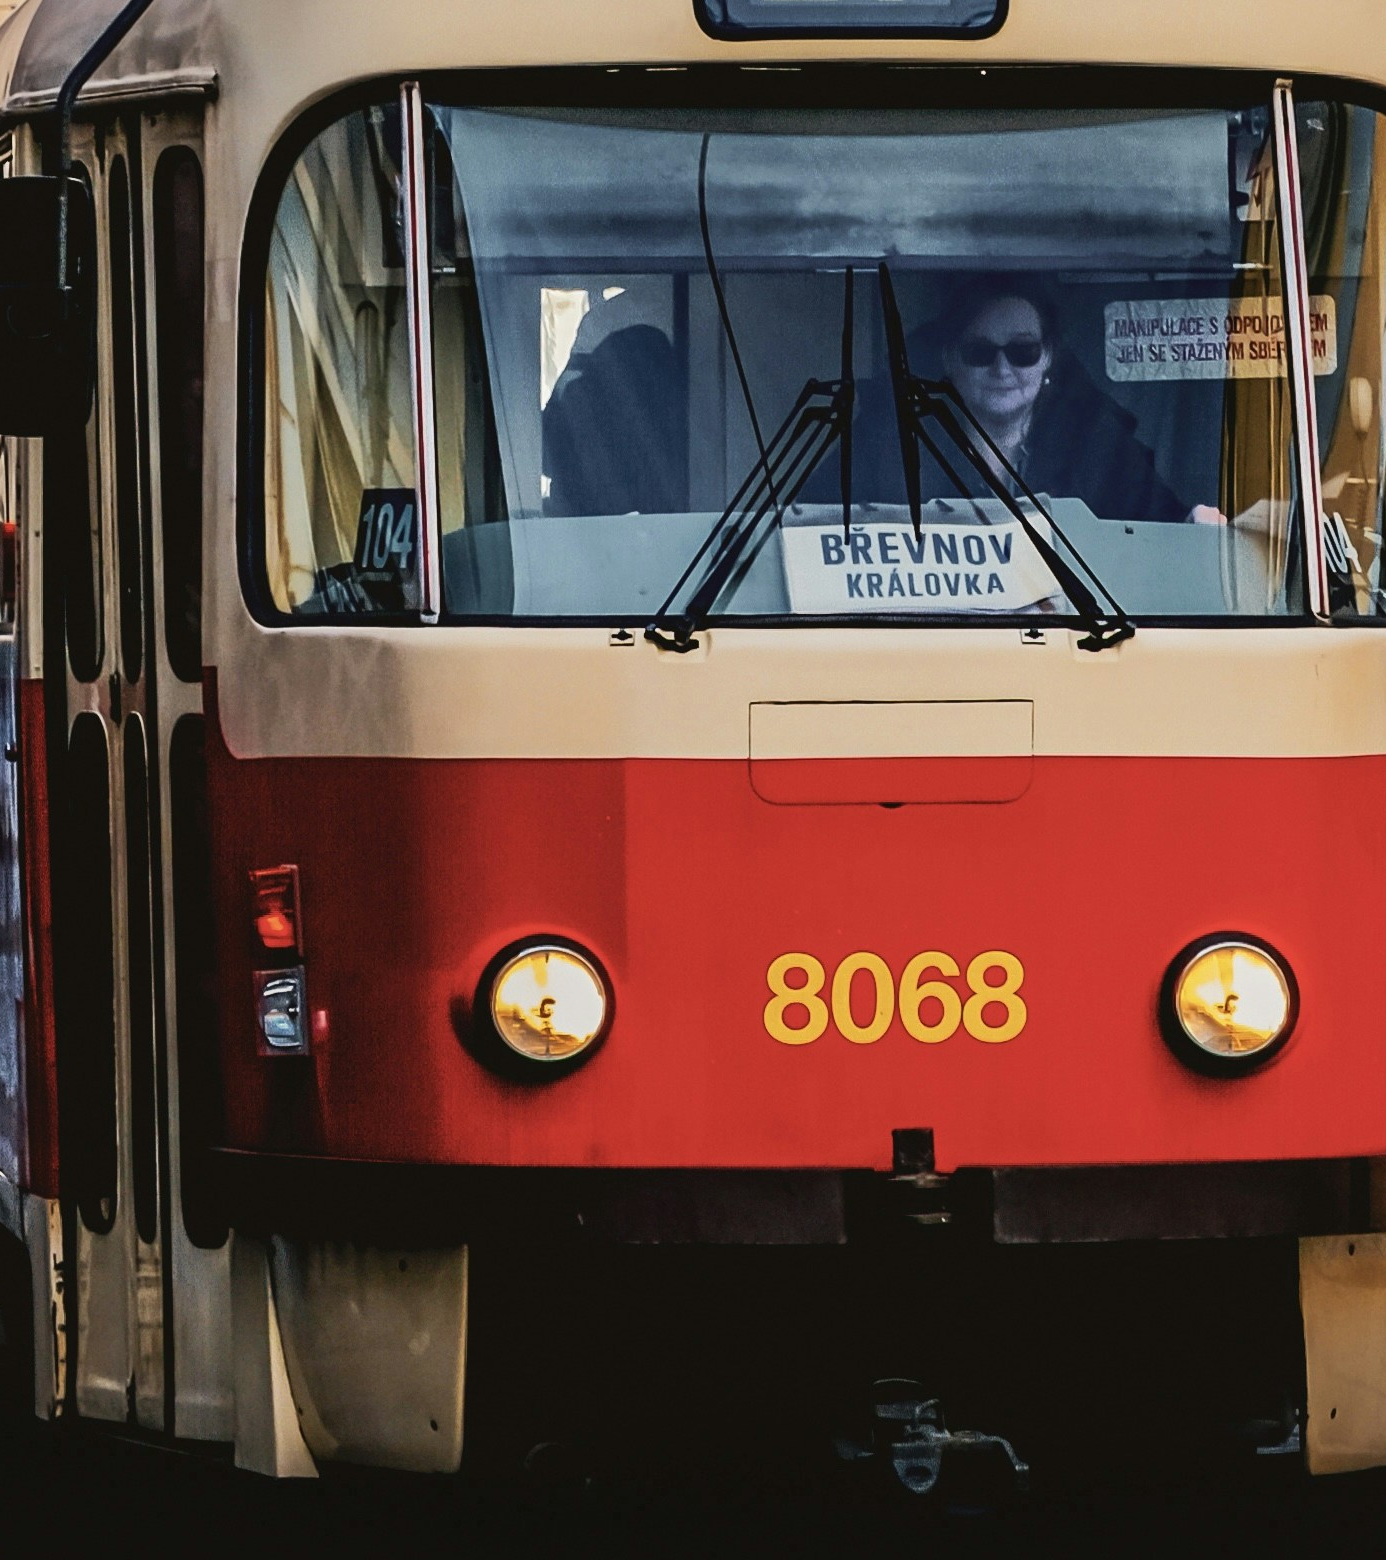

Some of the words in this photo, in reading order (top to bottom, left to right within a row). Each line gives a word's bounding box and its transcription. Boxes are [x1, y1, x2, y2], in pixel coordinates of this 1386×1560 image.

[1114, 316, 1204, 337] MANIPULACE
[1210, 316, 1218, 335] S
[1117, 343, 1143, 363] JEN
[1149, 343, 1166, 362] SE
[1171, 335, 1244, 362] STAŽENÝM
[362, 503, 413, 568] 104
[821, 527, 1012, 565] BŘEVNOV
[846, 568, 1005, 598] KRÁLOVKA
[763, 949, 1027, 1046] 8068
